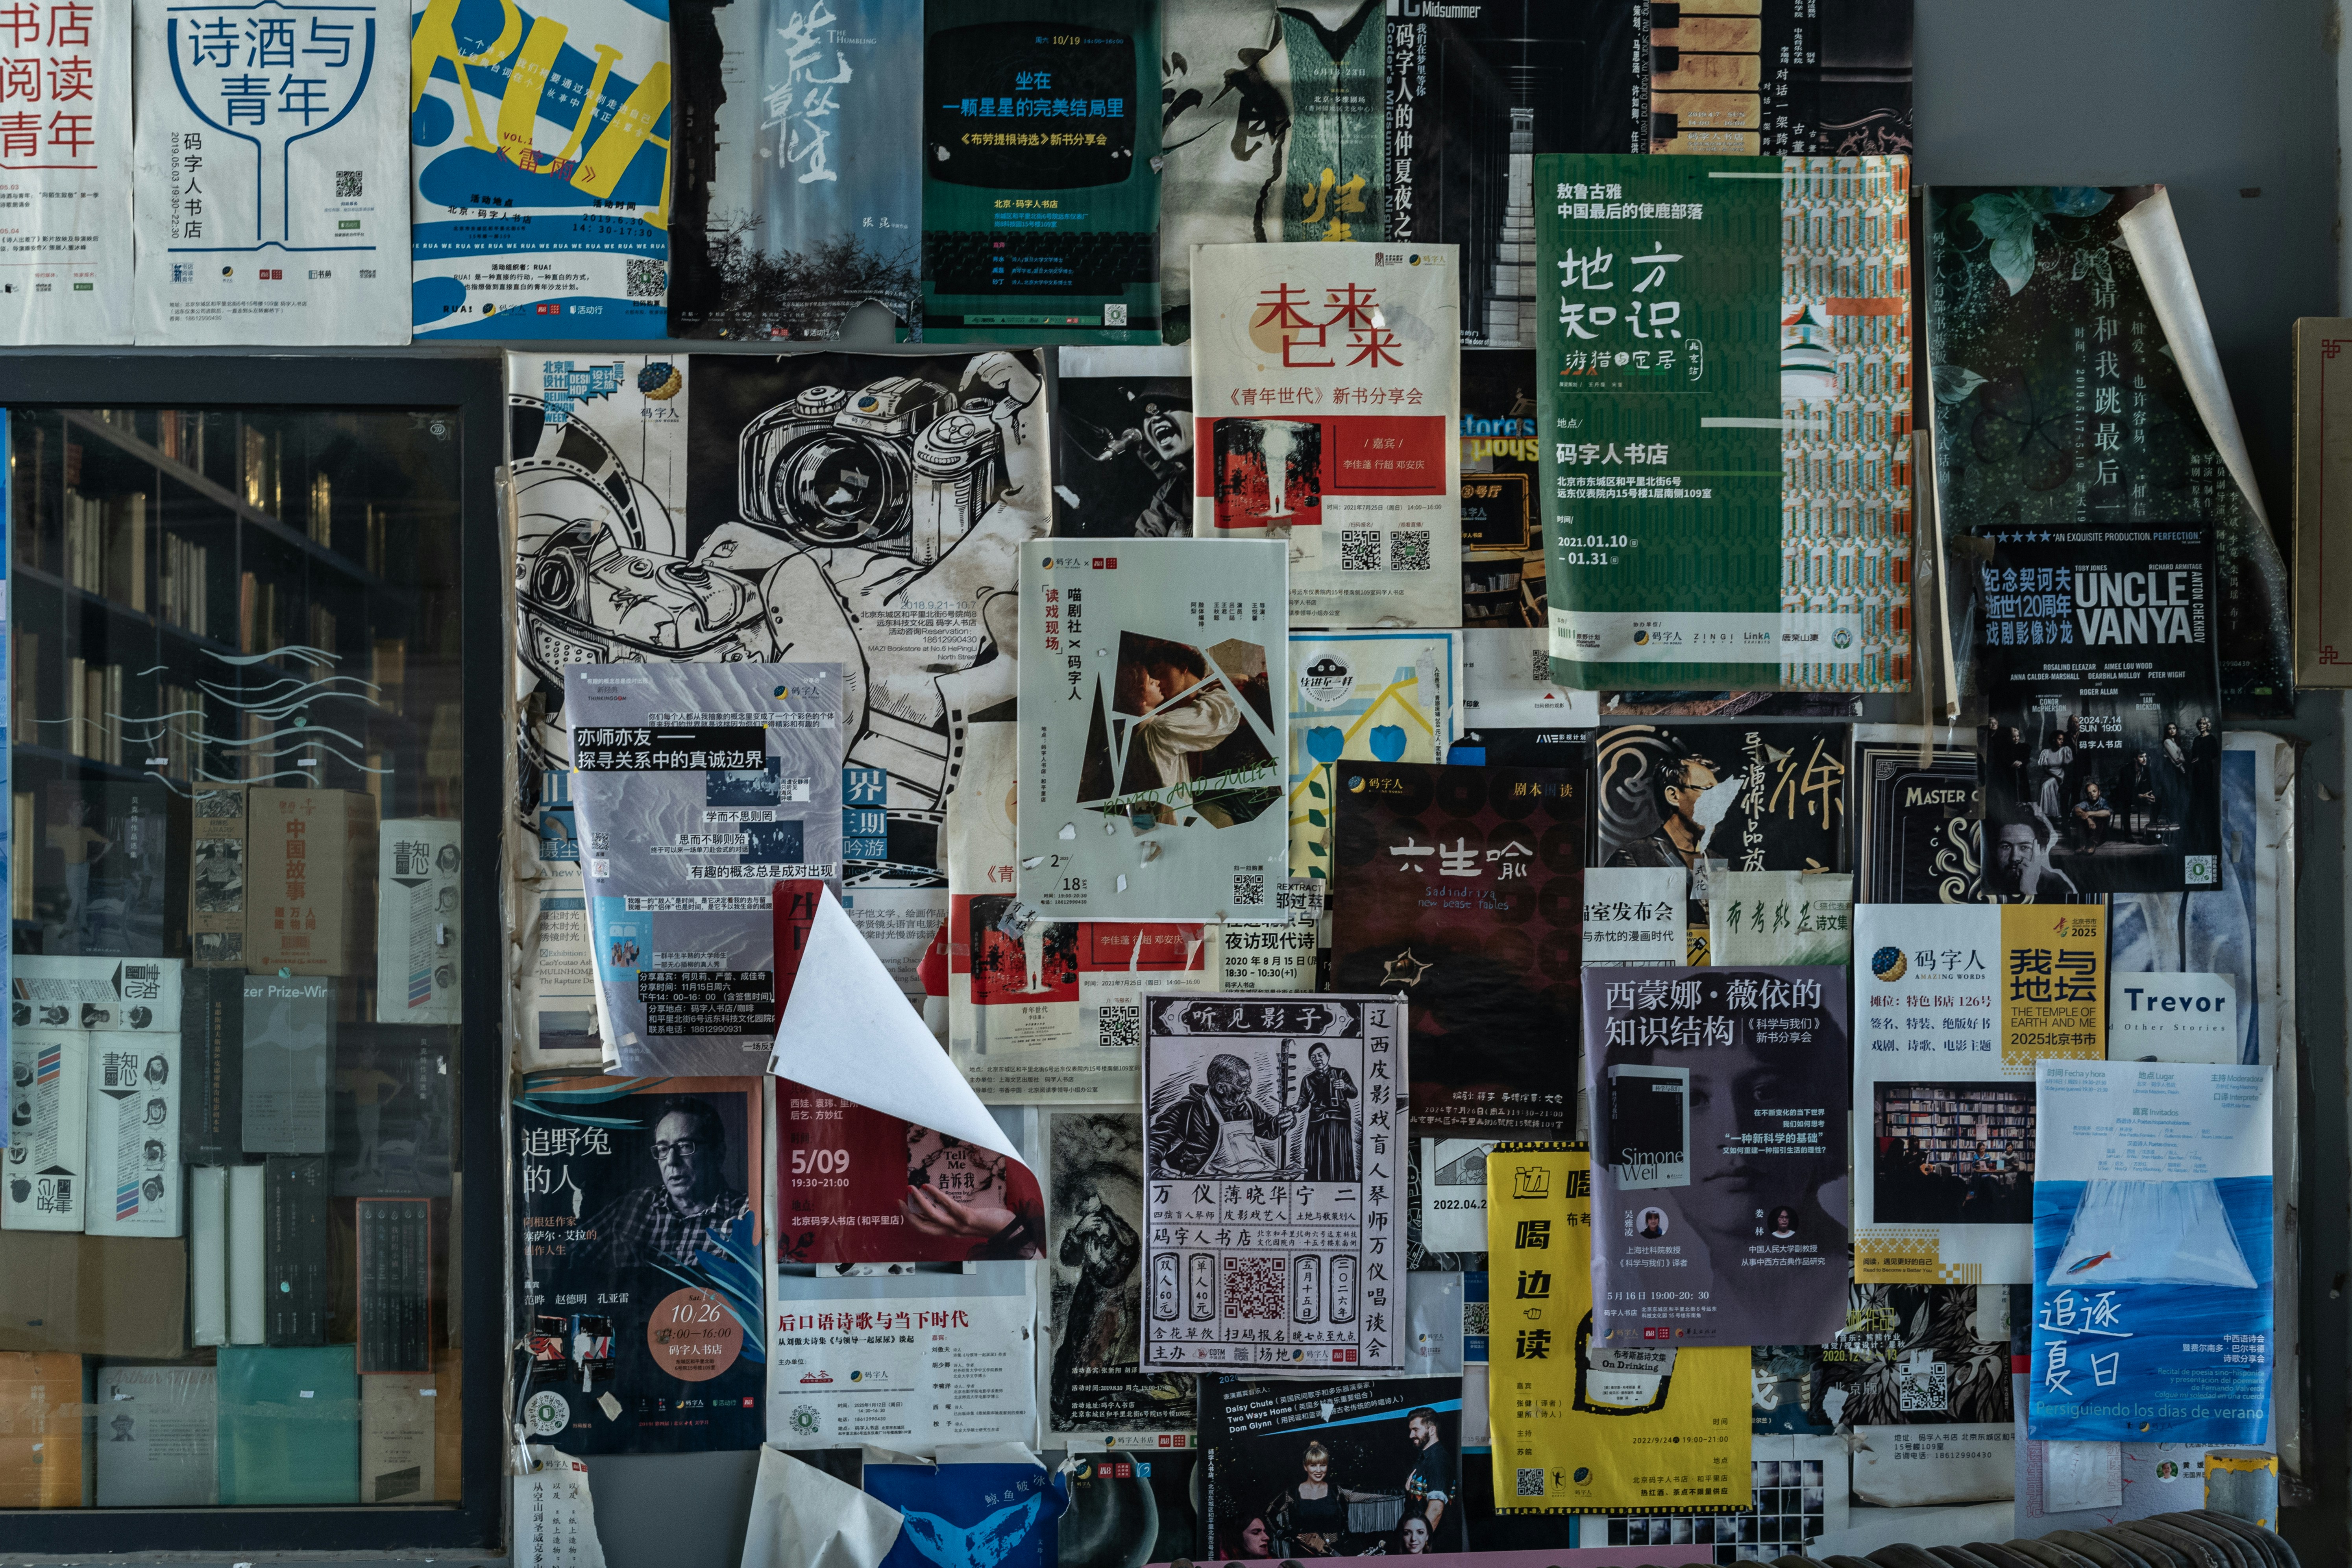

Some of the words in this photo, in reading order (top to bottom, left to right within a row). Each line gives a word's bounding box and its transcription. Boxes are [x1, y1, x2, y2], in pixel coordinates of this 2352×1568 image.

[1423, 2, 1481, 18] Midsummer
[0, 2, 89, 48] 书店
[188, 15, 353, 68] 诗酒与
[1054, 35, 1080, 45] 10/19
[1416, 23, 1427, 96] 我们在梦里等你
[0, 55, 94, 104] 阅读
[1015, 71, 1051, 90] 坐在
[220, 73, 330, 127] 青年
[943, 98, 1124, 117] 一颗星星的完美结局里
[1, 110, 94, 158] 青年
[504, 132, 533, 145] VOL.1
[962, 133, 1107, 146] 《布劳提根诗选》新书分享会
[1686, 131, 1746, 141] 码字人书店
[184, 133, 202, 238] 码字人书店
[1557, 183, 1622, 200] 敖鲁古雅
[581, 213, 645, 227] 2019.6.30
[1558, 203, 1703, 220] 中国最后的使鹿部落
[1557, 240, 1684, 293] 地方
[444, 303, 472, 312] RUA!
[497, 304, 525, 314] 码字人
[578, 306, 603, 314] 活动行
[1255, 283, 1380, 328] 未来
[1559, 296, 1681, 339] 知识
[1231, 387, 1423, 405] 《青年世代》新书分享会
[2093, 281, 2121, 509] 请和我跳最后一
[1556, 444, 1668, 466] 码字人书店
[1375, 460, 1393, 470] 行超
[1396, 460, 1424, 469] 邓安庆
[1557, 477, 1681, 486] 北京市东城区和平里北街6号
[1557, 488, 1711, 498] 远东仪表院内15号楼1层南侧109室
[1559, 535, 1627, 547] 2021.01.10
[2067, 533, 2103, 542] EXQUISITE
[2105, 533, 2152, 541] PRODUCTION.
[1985, 567, 2071, 593] 纪念契诃夫
[2193, 572, 2203, 599] ANTON
[2075, 572, 2189, 607] UNCLE
[2076, 608, 2193, 645] VANYA
[2193, 603, 2205, 643] CHEKHOV
[1652, 632, 1682, 641] 码字人
[1986, 620, 2073, 645] 戏剧影像沙龙
[2079, 740, 2122, 749] 码字人书店
[579, 750, 765, 771] 探寻关系中的真诚边界
[1369, 778, 1403, 789] 码字人
[679, 833, 747, 845] 思而不聊则殆
[651, 845, 749, 854] 终于可以来一场单刀赴会式的对话
[1389, 836, 1533, 880] 六生喻
[286, 818, 306, 902] 中国故事
[692, 864, 834, 879] 有趣的概念总是成对出现
[1426, 886, 1496, 899] Sadindriya
[1443, 900, 1472, 908] beast
[1478, 900, 1509, 910] fables
[1225, 930, 1316, 952] 夜访现代诗
[2072, 928, 2096, 937] 2025
[1914, 949, 1986, 972] 码字人
[2010, 948, 2097, 976] 我与
[1605, 979, 1821, 1011] 西蒙娜·薇依的
[2010, 976, 2097, 1003] 地坛
[2125, 988, 2225, 1013] Trevor
[1192, 1007, 1322, 1031] 听见影子
[2012, 1008, 2032, 1017] THE
[2035, 1008, 2078, 1017] TEMPLE
[2080, 1007, 2096, 1017] OF
[1871, 1018, 1990, 1029] 签名、特装、绝版好书
[2011, 1018, 2047, 1027] EARTH
[2052, 1018, 2075, 1027] AND
[2080, 1018, 2096, 1027] ME
[1605, 1016, 1734, 1048] 知识结构
[2011, 1033, 2096, 1045] 2025北京书市
[1872, 1039, 1991, 1051] 戏剧、诗歌、电影主题
[2047, 1069, 2063, 1077] 时间
[2139, 1071, 2154, 1080] 地点
[2156, 1072, 2174, 1082] Lugar
[2133, 1108, 2148, 1116] 嘉宾
[522, 1127, 612, 1156] 追野兔
[791, 1148, 849, 1174] 5/09
[945, 1151, 966, 1160] Tell
[1620, 1145, 1683, 1170] Simone
[948, 1161, 965, 1169] Me
[1620, 1162, 1657, 1181] Weil
[939, 1172, 974, 1190] 告诉我
[1366, 1009, 1390, 1359] 辽西皮影戏盲人琴师万仪唱谈会
[1224, 1185, 1288, 1205] 薄晓华
[1154, 1227, 1251, 1246] 码字人书店
[1749, 1244, 1818, 1253] 中国人民大学副教授
[1742, 1257, 1825, 1266] 从事中西方古典作品研究
[555, 1294, 586, 1304] 赵德明
[672, 1302, 723, 1323] 10/26
[778, 1310, 969, 1332] 后口语诗歌与当下时代
[2039, 1289, 2133, 1336] 追逐
[2224, 1334, 2265, 1342] 中西语诗会
[669, 1344, 722, 1355] 码字人书店
[1617, 1361, 1658, 1372] Drinking
[2045, 1340, 2120, 1396] 夏日
[1251, 1400, 1273, 1409] Chute
[1270, 1407, 1292, 1415] Home
[2034, 1400, 2130, 1419] Persiguiendo
[2135, 1403, 2154, 1417] los
[2158, 1404, 2187, 1417] días
[2191, 1404, 2209, 1420] de
[2214, 1407, 2263, 1420] verano
[1249, 1420, 1272, 1430] Glynn
[1641, 1488, 1727, 1496] 热红酒、茶点不限量供应
